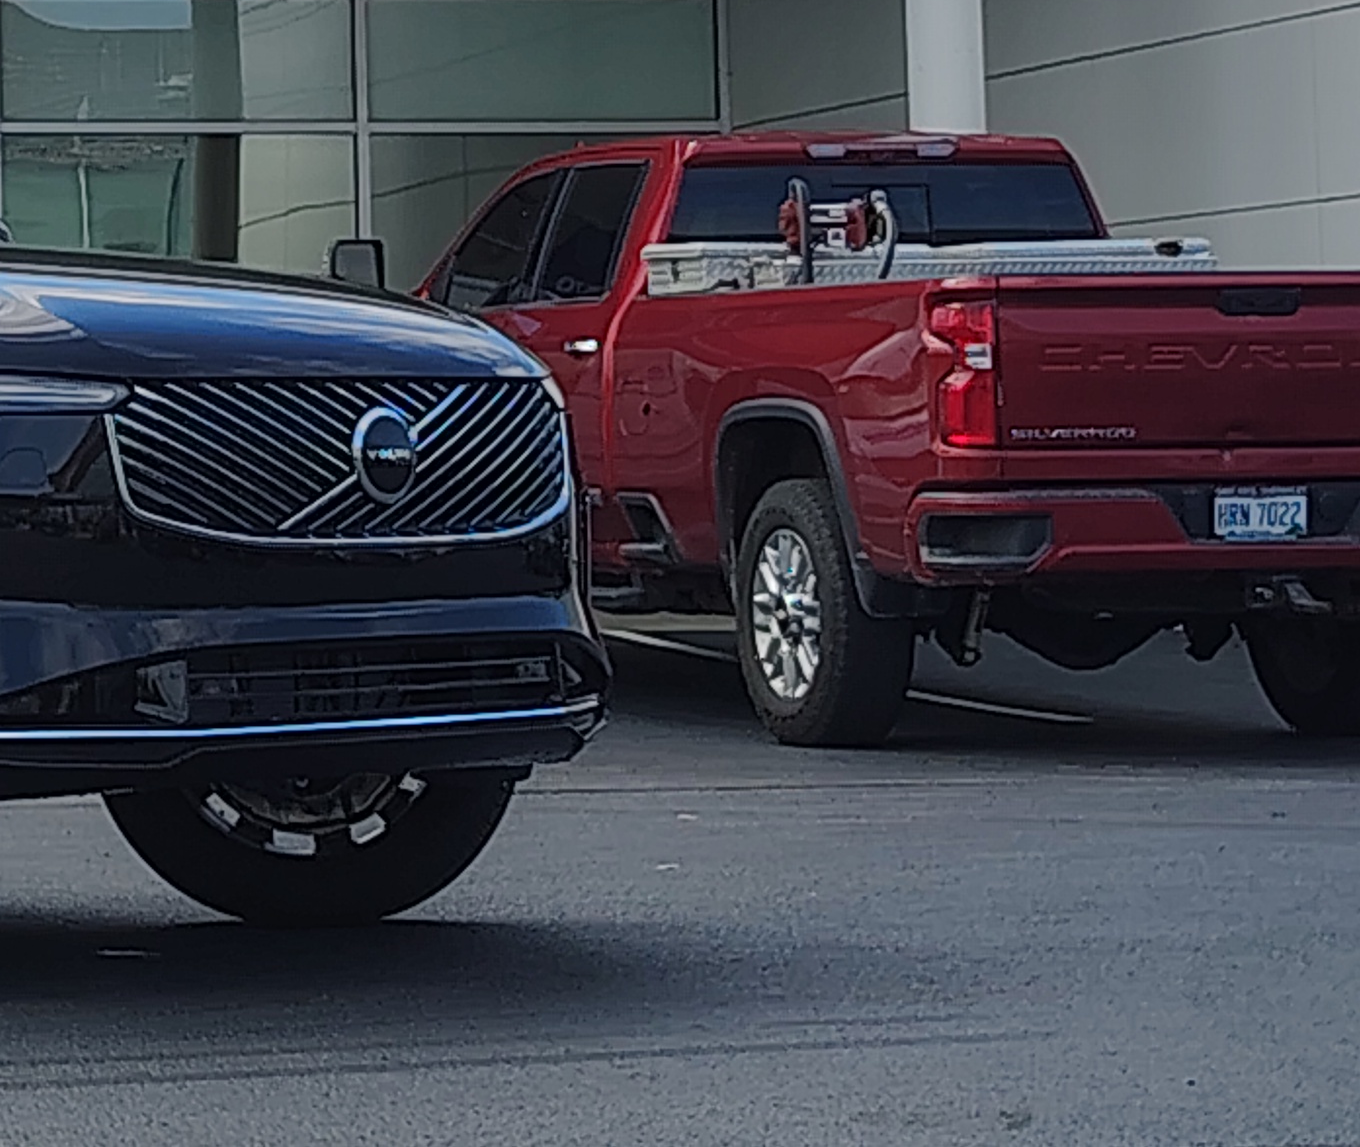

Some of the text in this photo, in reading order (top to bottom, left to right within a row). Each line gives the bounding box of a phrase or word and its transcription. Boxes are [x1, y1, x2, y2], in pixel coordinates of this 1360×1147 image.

[1038, 343, 1360, 371] CHEVRO
[1010, 427, 1137, 440] SILVERADO
[366, 448, 412, 462] VOLVO
[1218, 501, 1301, 529] HRN 7022
